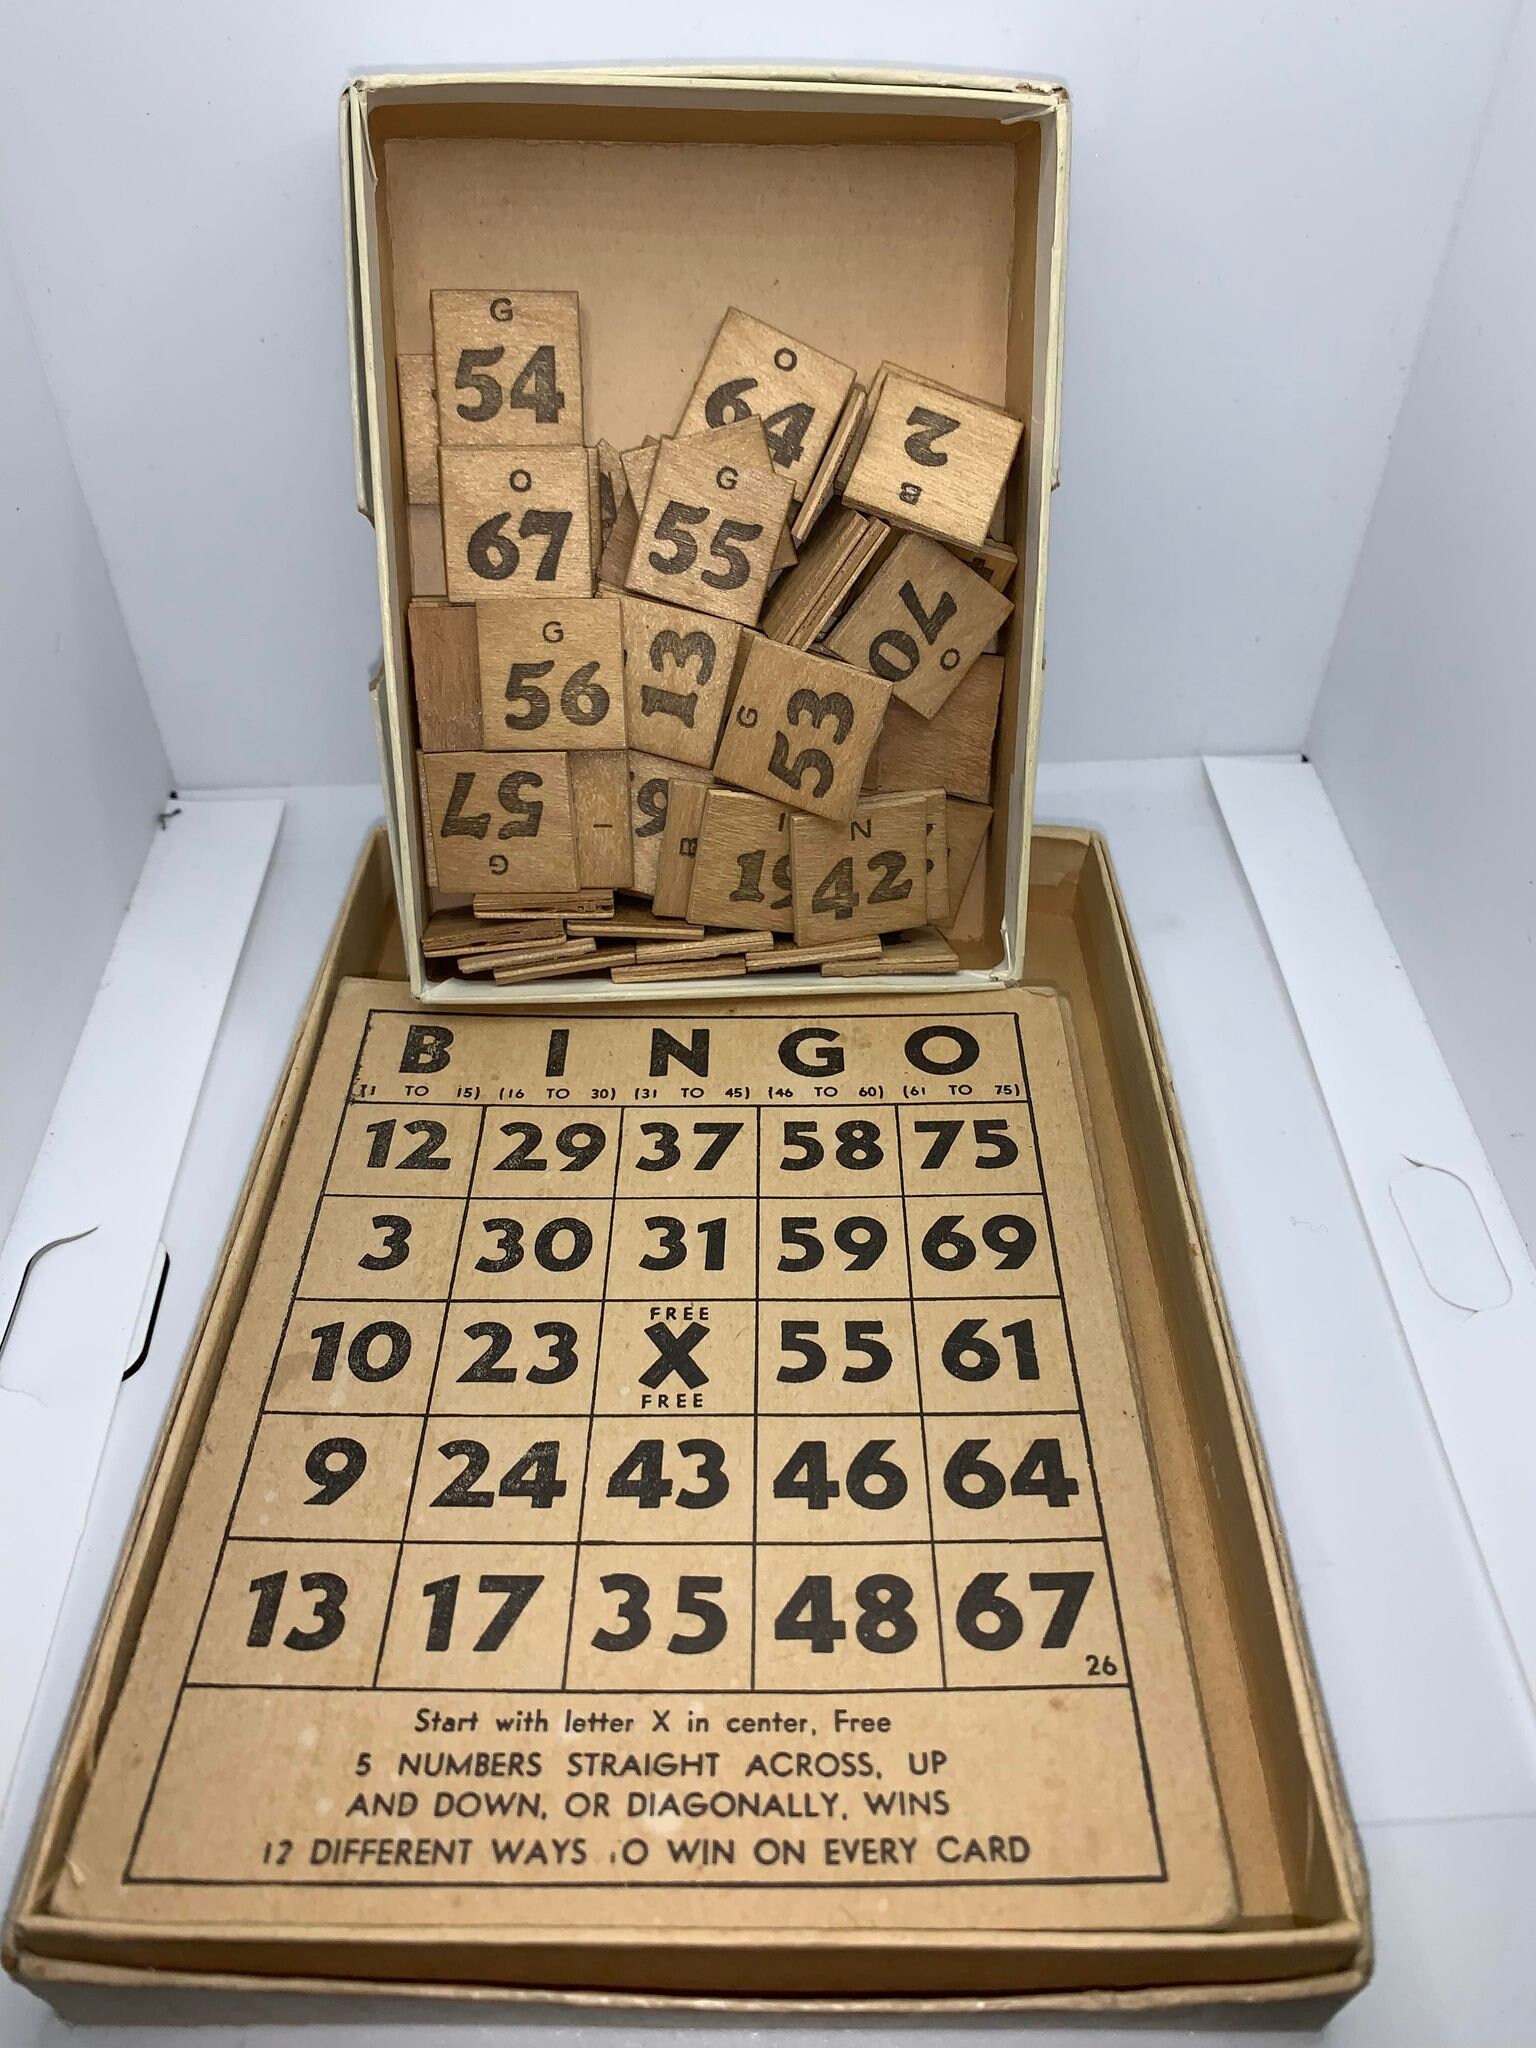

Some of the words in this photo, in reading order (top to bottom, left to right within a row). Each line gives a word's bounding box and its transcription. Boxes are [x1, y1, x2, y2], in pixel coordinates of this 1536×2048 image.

[489, 297, 514, 322] G
[454, 345, 566, 424] 54
[704, 377, 816, 469] 64
[903, 406, 962, 468] 2
[715, 466, 739, 491] G
[899, 482, 923, 505] B
[467, 509, 573, 581] 67
[647, 500, 764, 591] 55
[541, 620, 565, 643] G
[868, 579, 959, 683] 70
[504, 659, 611, 731] 56
[640, 629, 717, 730] 13
[736, 704, 758, 729] G
[767, 687, 855, 799] 53
[440, 770, 544, 841] 57
[850, 818, 873, 842] N
[488, 854, 510, 876] G
[811, 849, 914, 921] 42
[404, 1085, 430, 1097] TO
[456, 1084, 481, 1100] 15)
[499, 1086, 525, 1101] (16
[545, 1087, 571, 1099] TO
[590, 1086, 616, 1101] 30)
[634, 1086, 658, 1101] (31
[680, 1087, 705, 1099] TO
[724, 1086, 751, 1100] 45)
[768, 1086, 794, 1100] (46
[813, 1086, 838, 1098] TO
[858, 1085, 885, 1100] 60)
[902, 1085, 927, 1099] (61
[948, 1084, 974, 1096] TO
[994, 1083, 1021, 1098] 75)
[366, 1118, 452, 1170] 12
[493, 1121, 607, 1172] 29
[635, 1121, 745, 1172] 37
[779, 1119, 884, 1171] 58
[914, 1119, 1019, 1170] 75
[357, 1214, 412, 1271] 3
[474, 1217, 593, 1273] 30
[638, 1215, 727, 1272] 31
[777, 1215, 888, 1273] 59
[921, 1214, 1037, 1271] 69
[650, 1306, 710, 1321] FREE
[310, 1320, 412, 1383] 10
[456, 1321, 579, 1384] 23
[639, 1321, 711, 1389] X
[776, 1320, 893, 1383] 55
[941, 1318, 1041, 1382] 61
[641, 1392, 704, 1409] FREE
[303, 1437, 367, 1506] 9
[429, 1439, 567, 1509] 24
[605, 1438, 730, 1510] 43
[772, 1439, 908, 1510] 46
[943, 1438, 1080, 1509] 64
[246, 1570, 349, 1652] 13
[422, 1574, 545, 1652] 17
[590, 1573, 728, 1655] 35
[774, 1573, 918, 1655] 48
[955, 1572, 1095, 1652] 67
[1085, 1654, 1118, 1676] 26
[414, 1707, 479, 1733] Start
[495, 1709, 549, 1733] with
[564, 1709, 634, 1733] letter
[652, 1709, 670, 1733] X
[687, 1710, 710, 1733] in
[726, 1711, 817, 1736] center,
[834, 1709, 892, 1733] Free
[355, 1752, 371, 1777] 5
[398, 1752, 542, 1777] NUMBERS
[567, 1752, 720, 1777] STRAIGHT
[745, 1751, 882, 1779] ACROSS,
[908, 1750, 947, 1775] UP
[345, 1792, 418, 1817] AND
[434, 1791, 548, 1820] DOWN,
[565, 1791, 610, 1817] OR
[627, 1791, 847, 1820] DIAGONALLY,
[863, 1789, 950, 1816] WINS
[310, 1838, 473, 1866] DIFFERENT
[491, 1838, 587, 1865] WAYS
[667, 1838, 735, 1865] WIN
[753, 1838, 805, 1866] ON
[824, 1837, 917, 1866] EVERY
[937, 1834, 1030, 1864] CARD
